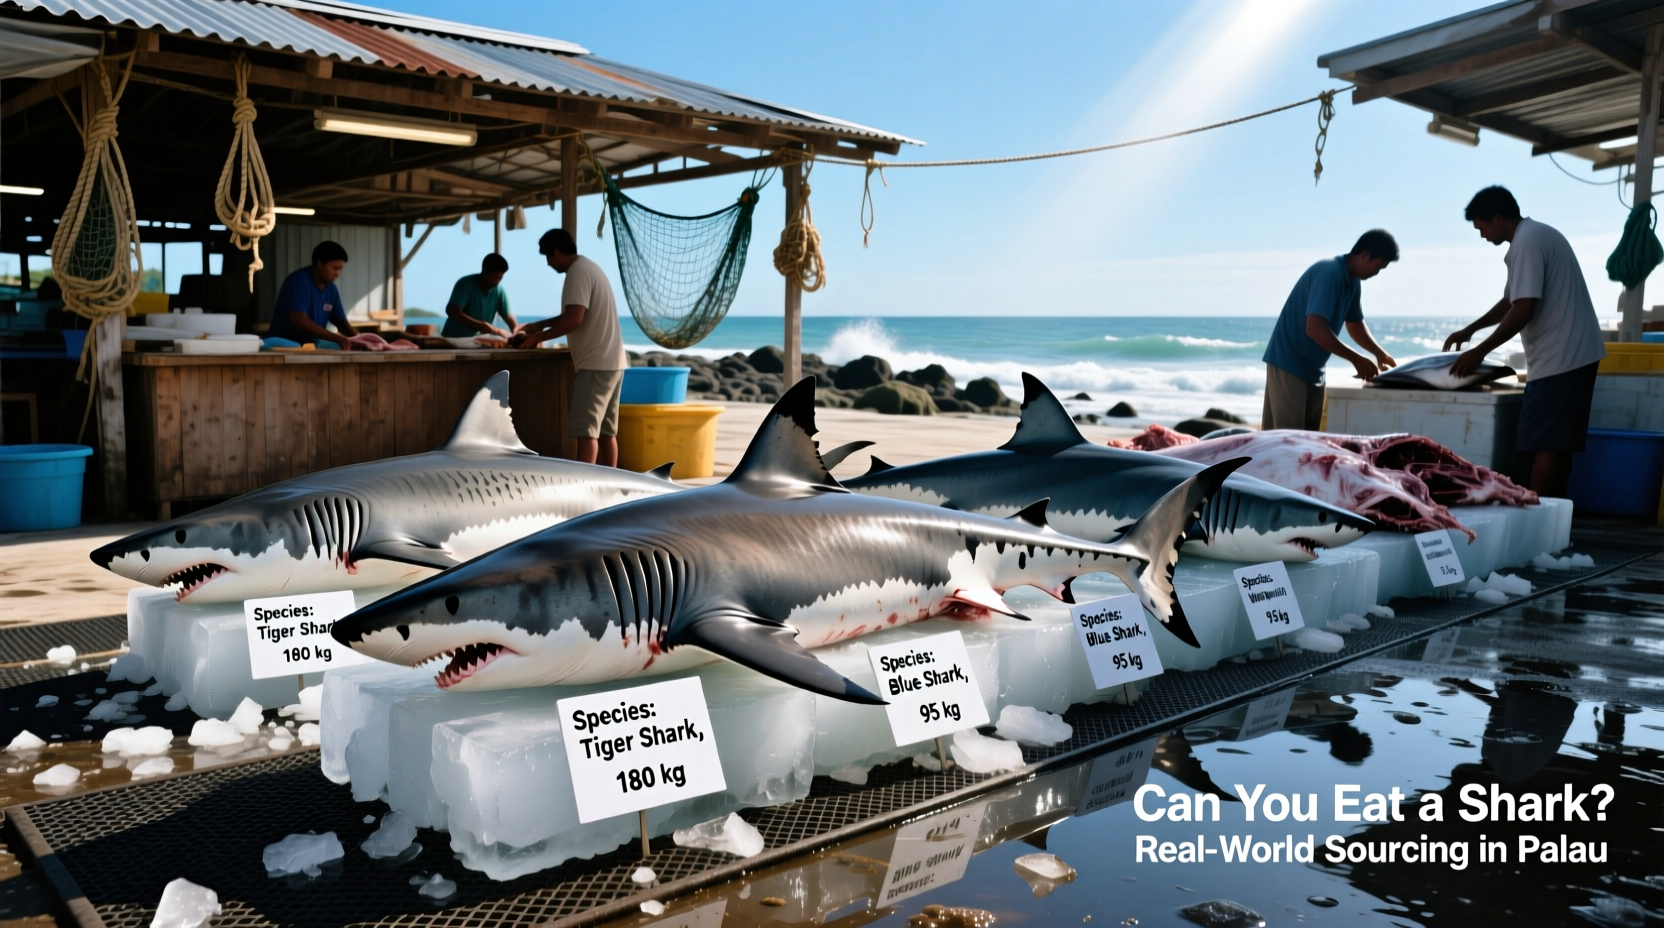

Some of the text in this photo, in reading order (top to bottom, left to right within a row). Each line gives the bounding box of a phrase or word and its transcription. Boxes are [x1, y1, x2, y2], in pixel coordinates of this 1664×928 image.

[254, 604, 314, 623] Species:
[257, 619, 335, 643] Tiger Shar
[1086, 623, 1146, 647] Blue Shark,
[283, 645, 332, 663] 180 kg
[880, 650, 935, 673] Species:
[1112, 653, 1128, 670] 95
[889, 663, 969, 695] Blue Shark,
[572, 701, 657, 733] Species:
[920, 701, 961, 723] 95 kg
[580, 718, 704, 761] Tiger Shark,
[616, 763, 687, 793] 180 kg
